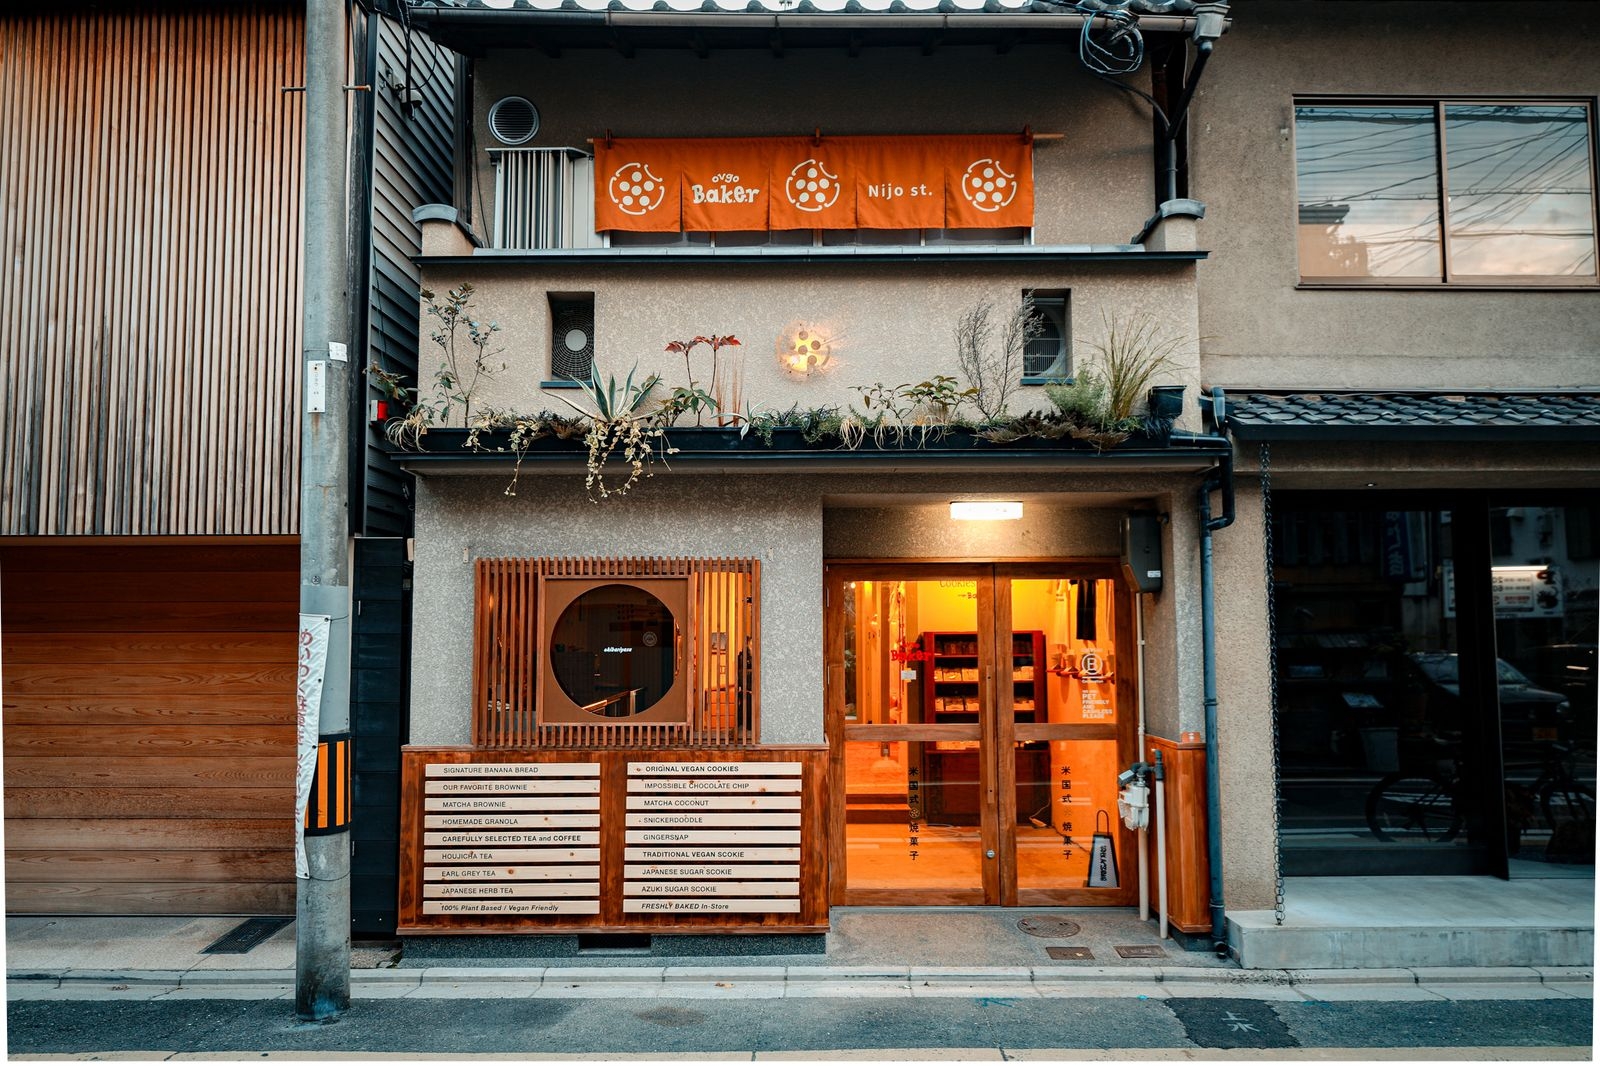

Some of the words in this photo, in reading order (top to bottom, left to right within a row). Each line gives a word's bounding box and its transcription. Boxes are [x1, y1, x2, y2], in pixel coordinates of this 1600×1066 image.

[711, 173, 739, 183] ovgo
[868, 183, 904, 200] Nijo
[910, 184, 932, 197] st.
[909, 766, 919, 804] 米国式
[1061, 765, 1072, 803] 米国式
[909, 822, 919, 860] 焼菓子
[1062, 821, 1073, 860] 焼菓子
